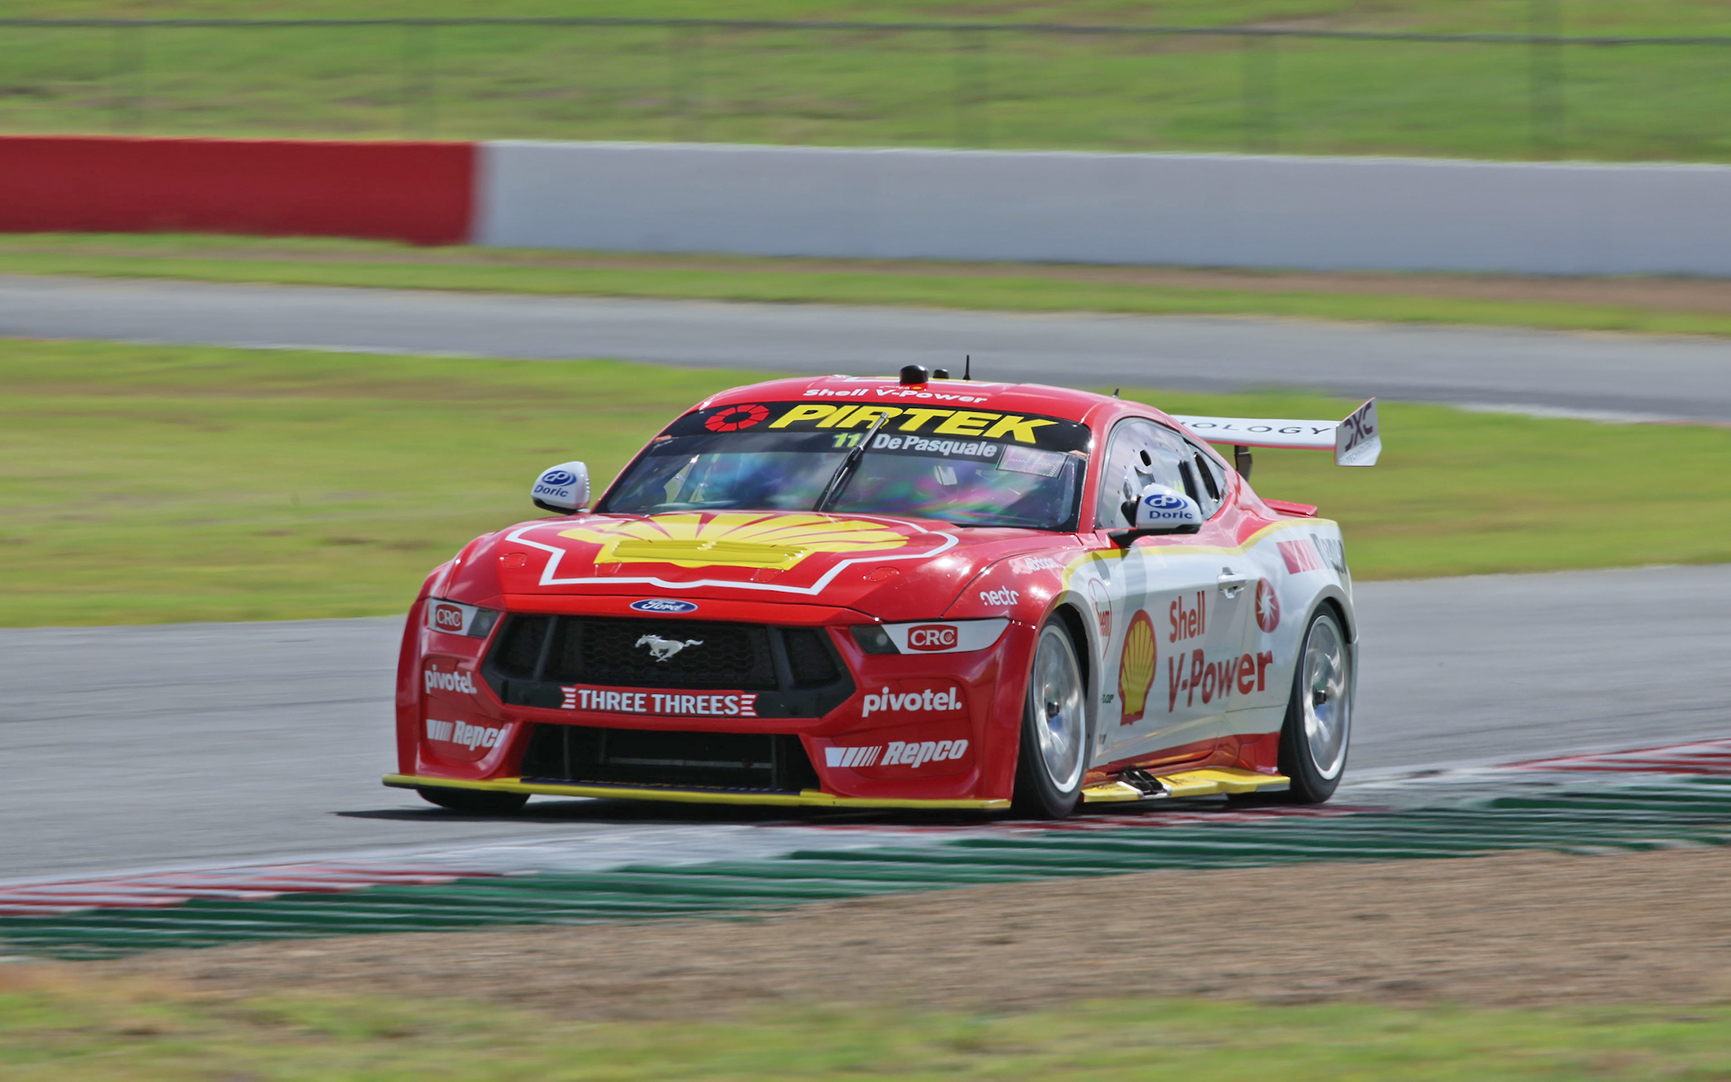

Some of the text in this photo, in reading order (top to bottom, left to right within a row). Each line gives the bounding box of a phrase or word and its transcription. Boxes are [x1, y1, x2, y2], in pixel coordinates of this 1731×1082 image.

[803, 388, 987, 403] Shell V-Power
[768, 404, 1059, 444] PIRTEK
[1179, 422, 1333, 435] OLOGY
[1343, 401, 1374, 452] DXC
[832, 433, 997, 458] 11 De Pasquale
[534, 485, 568, 498] Doric
[1149, 510, 1193, 519] Doric
[641, 600, 686, 611] Ford
[979, 585, 1020, 606] nectr
[436, 608, 461, 627] CRC
[1169, 590, 1205, 643] Shell
[910, 629, 955, 646] CRC
[1168, 648, 1273, 713] V-Power
[578, 690, 740, 715] THREE THREES
[862, 686, 962, 717] pivotel.
[880, 739, 969, 768] Repco
